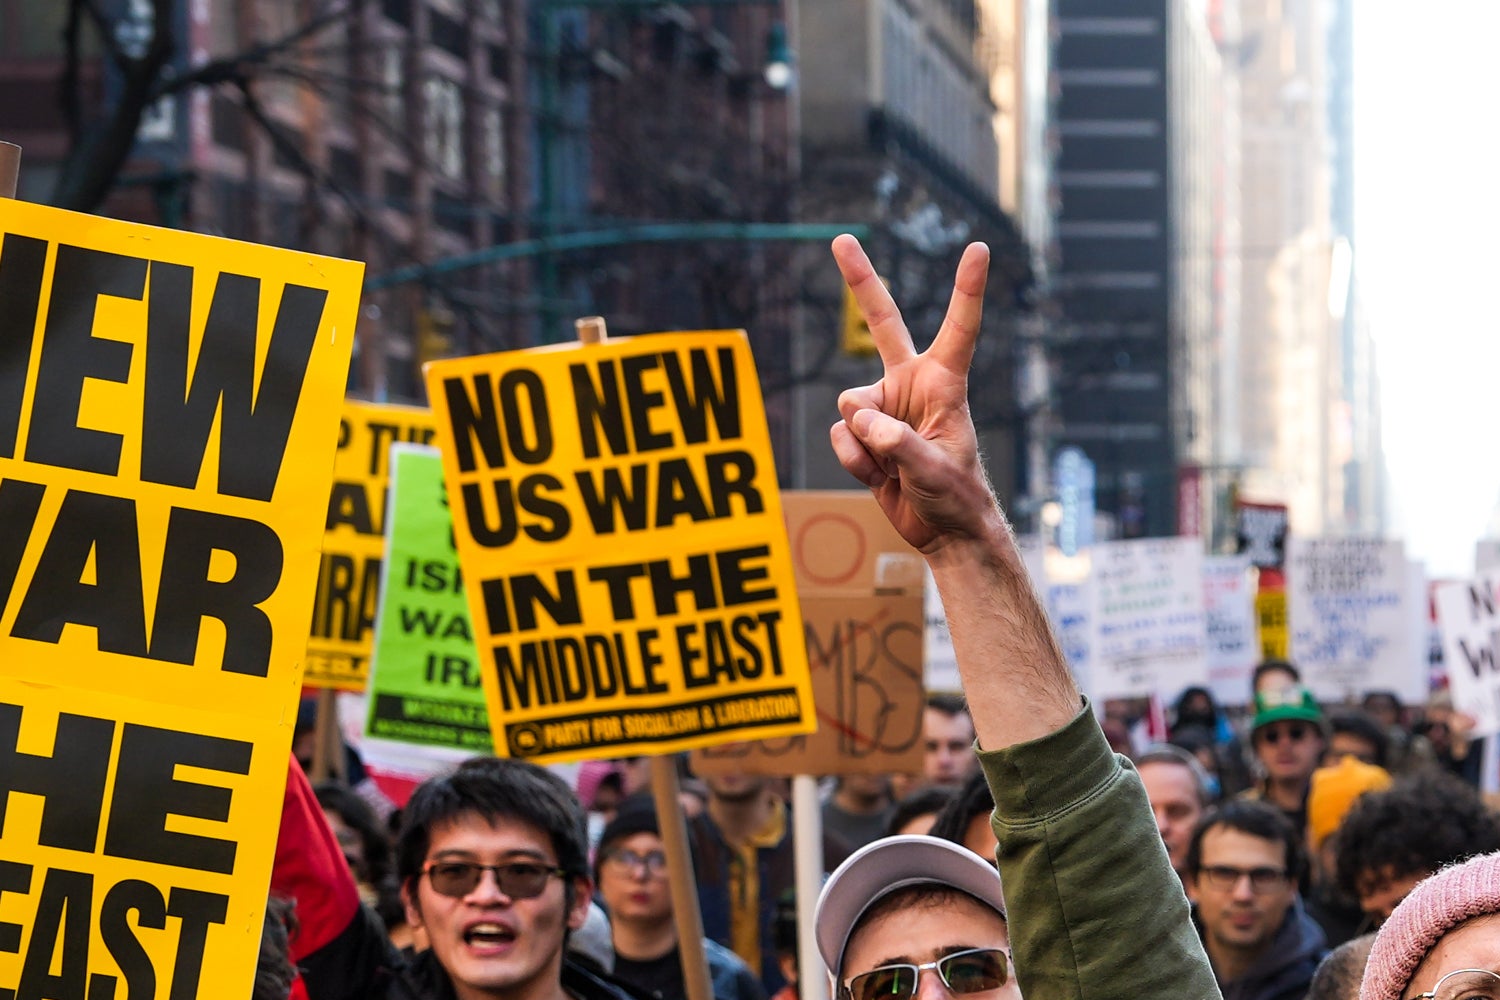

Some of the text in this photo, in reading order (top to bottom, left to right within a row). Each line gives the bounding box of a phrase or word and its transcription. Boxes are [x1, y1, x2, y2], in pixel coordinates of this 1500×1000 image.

[443, 368, 554, 472] NO
[570, 347, 743, 460] NEW
[462, 474, 571, 547] US
[575, 450, 763, 534] WAR
[481, 545, 778, 635] IN THE
[786, 512, 867, 586] O
[493, 611, 783, 711] MIDDLE EAST
[702, 616, 925, 758] MBS
[545, 694, 799, 748] PARTY FOR SOCIALISM & LIBERATION
[0, 704, 254, 875] HE
